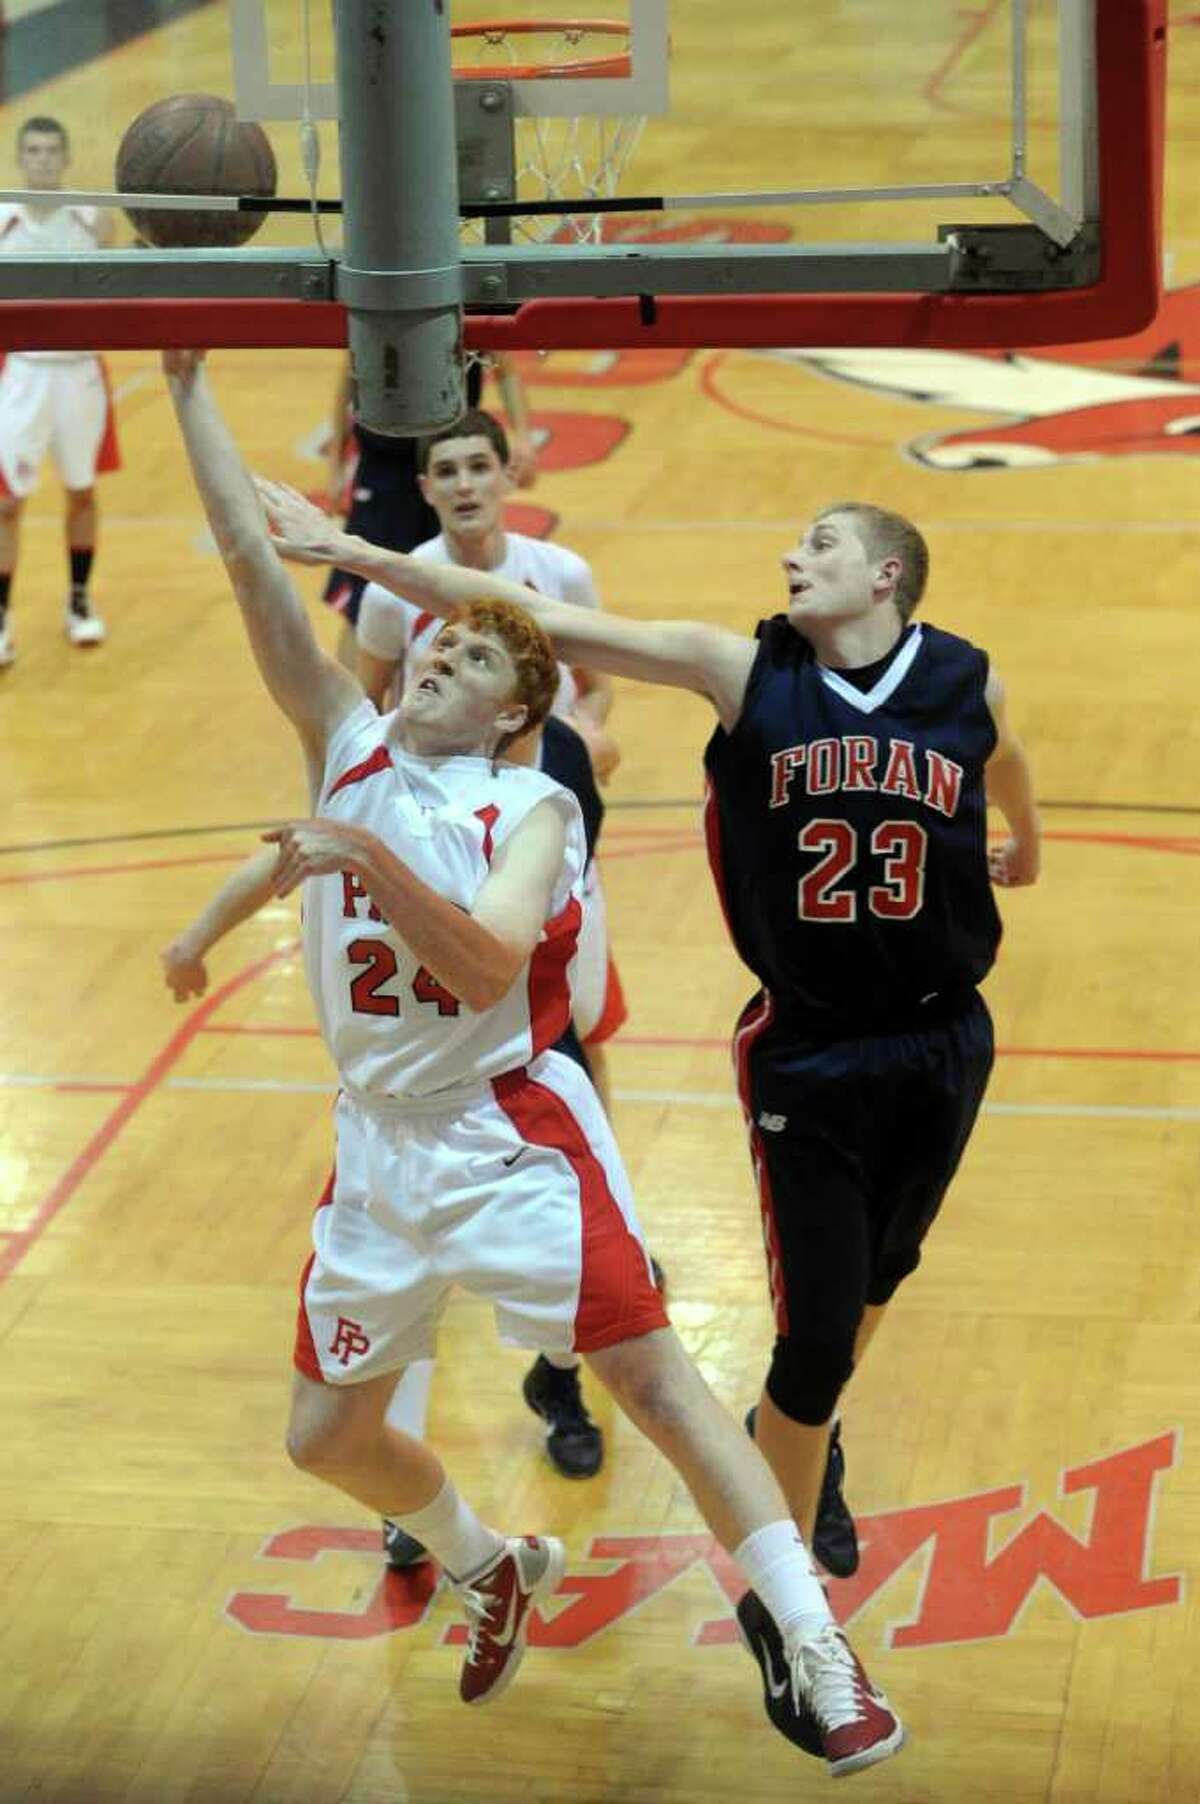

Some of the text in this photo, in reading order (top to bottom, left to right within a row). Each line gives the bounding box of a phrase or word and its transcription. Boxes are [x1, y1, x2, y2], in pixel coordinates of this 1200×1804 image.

[769, 735, 964, 818] FORAN
[798, 818, 928, 923] 23
[346, 938, 461, 1018] 24
